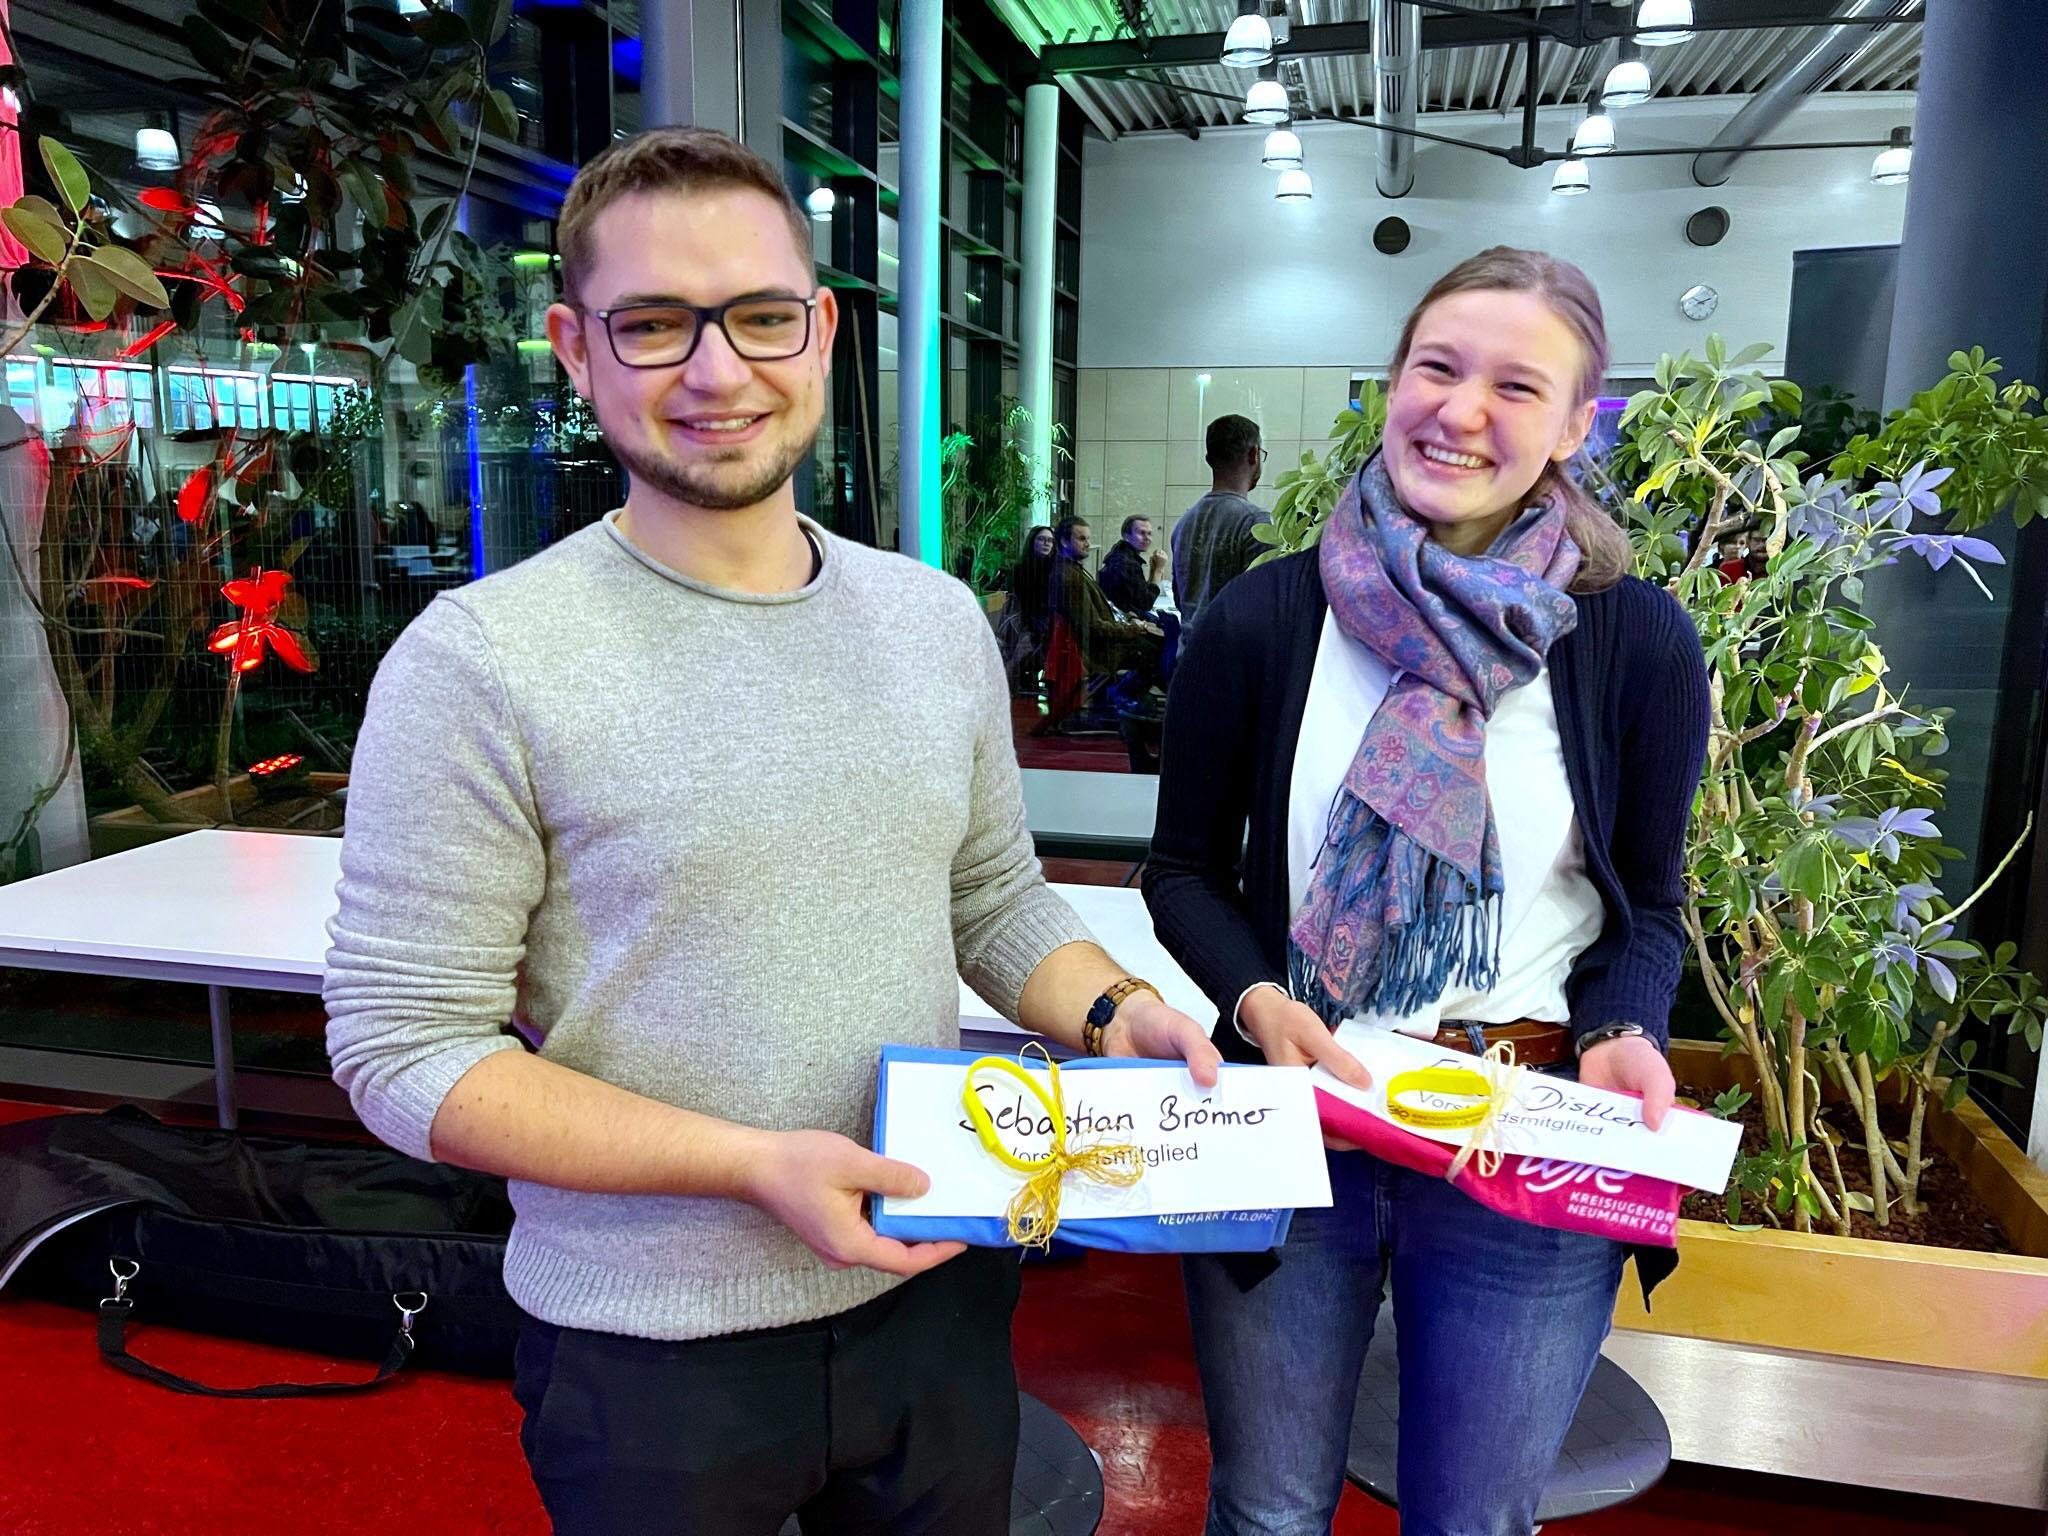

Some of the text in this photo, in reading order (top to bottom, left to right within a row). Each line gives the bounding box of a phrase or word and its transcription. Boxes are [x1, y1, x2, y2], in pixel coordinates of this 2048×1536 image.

[959, 1085, 1134, 1137] Sebastian
[1157, 1211, 1229, 1226] NEUMARKT
[1567, 1203, 1648, 1230] NEUMARKT
